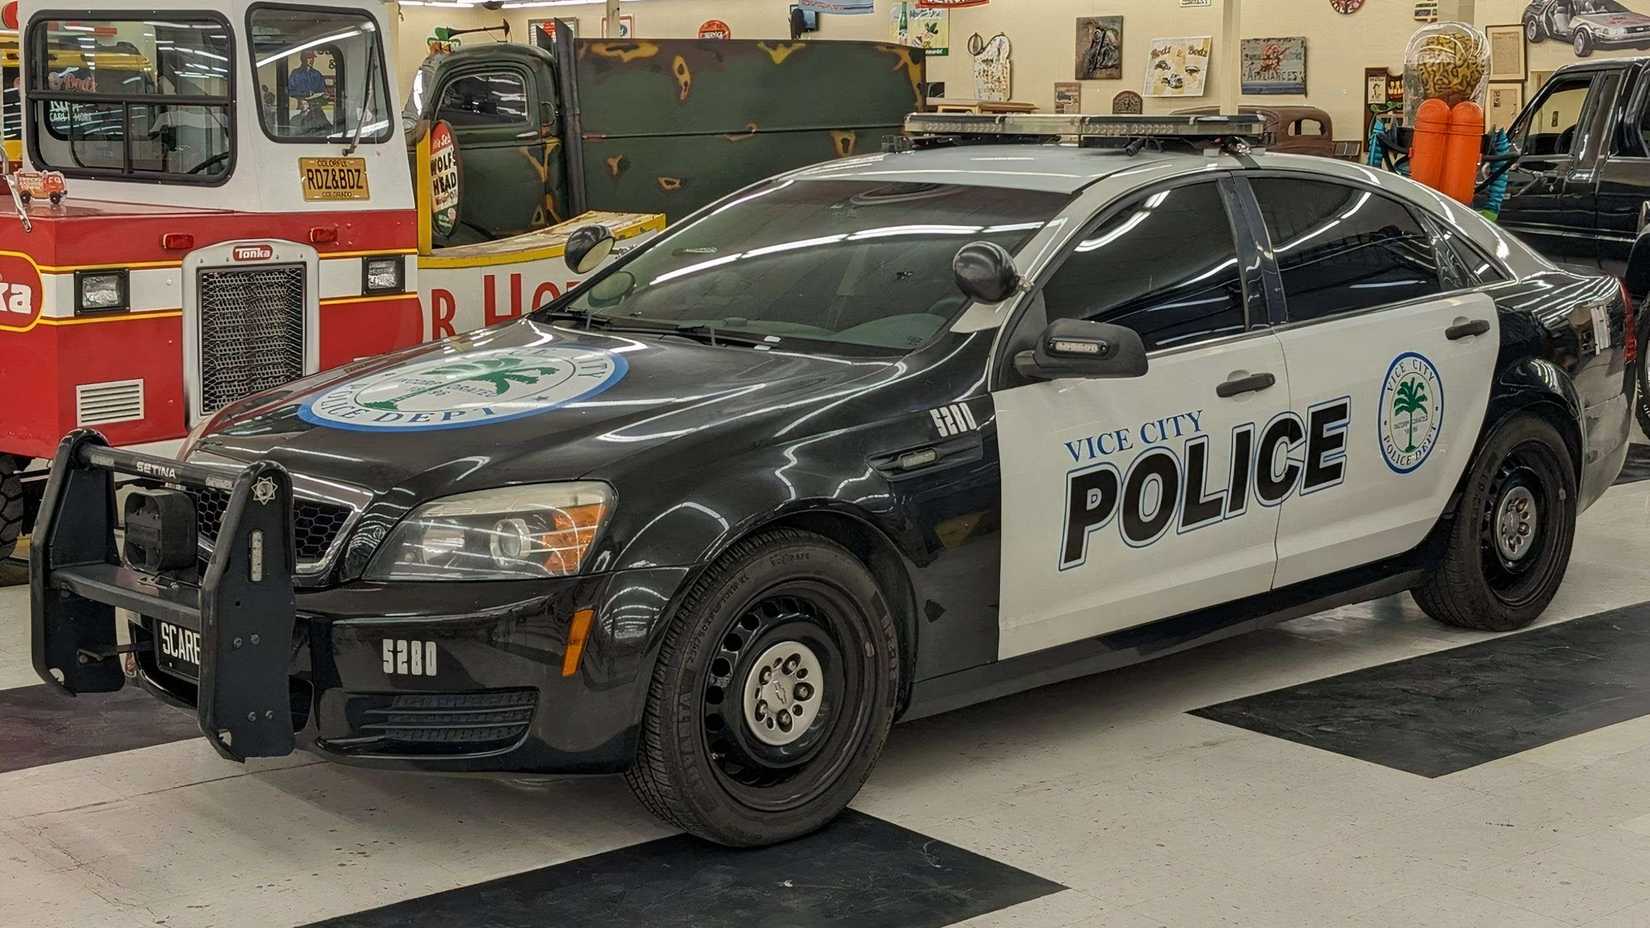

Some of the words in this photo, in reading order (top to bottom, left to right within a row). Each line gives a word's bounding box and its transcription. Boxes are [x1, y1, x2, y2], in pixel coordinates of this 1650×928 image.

[306, 168, 363, 190] RDZ&BDZ
[432, 172, 456, 196] HEAD
[235, 247, 271, 259] Tonka
[1386, 362, 1406, 392] VICE
[1411, 358, 1435, 382] CITY
[928, 402, 977, 437] 5280
[1064, 428, 1134, 463] VICE
[1139, 409, 1204, 445] CITY
[1383, 435, 1413, 466] POLICE
[136, 461, 177, 480] SETINA
[1059, 395, 1351, 572] POLICE
[382, 638, 438, 677] 5280
